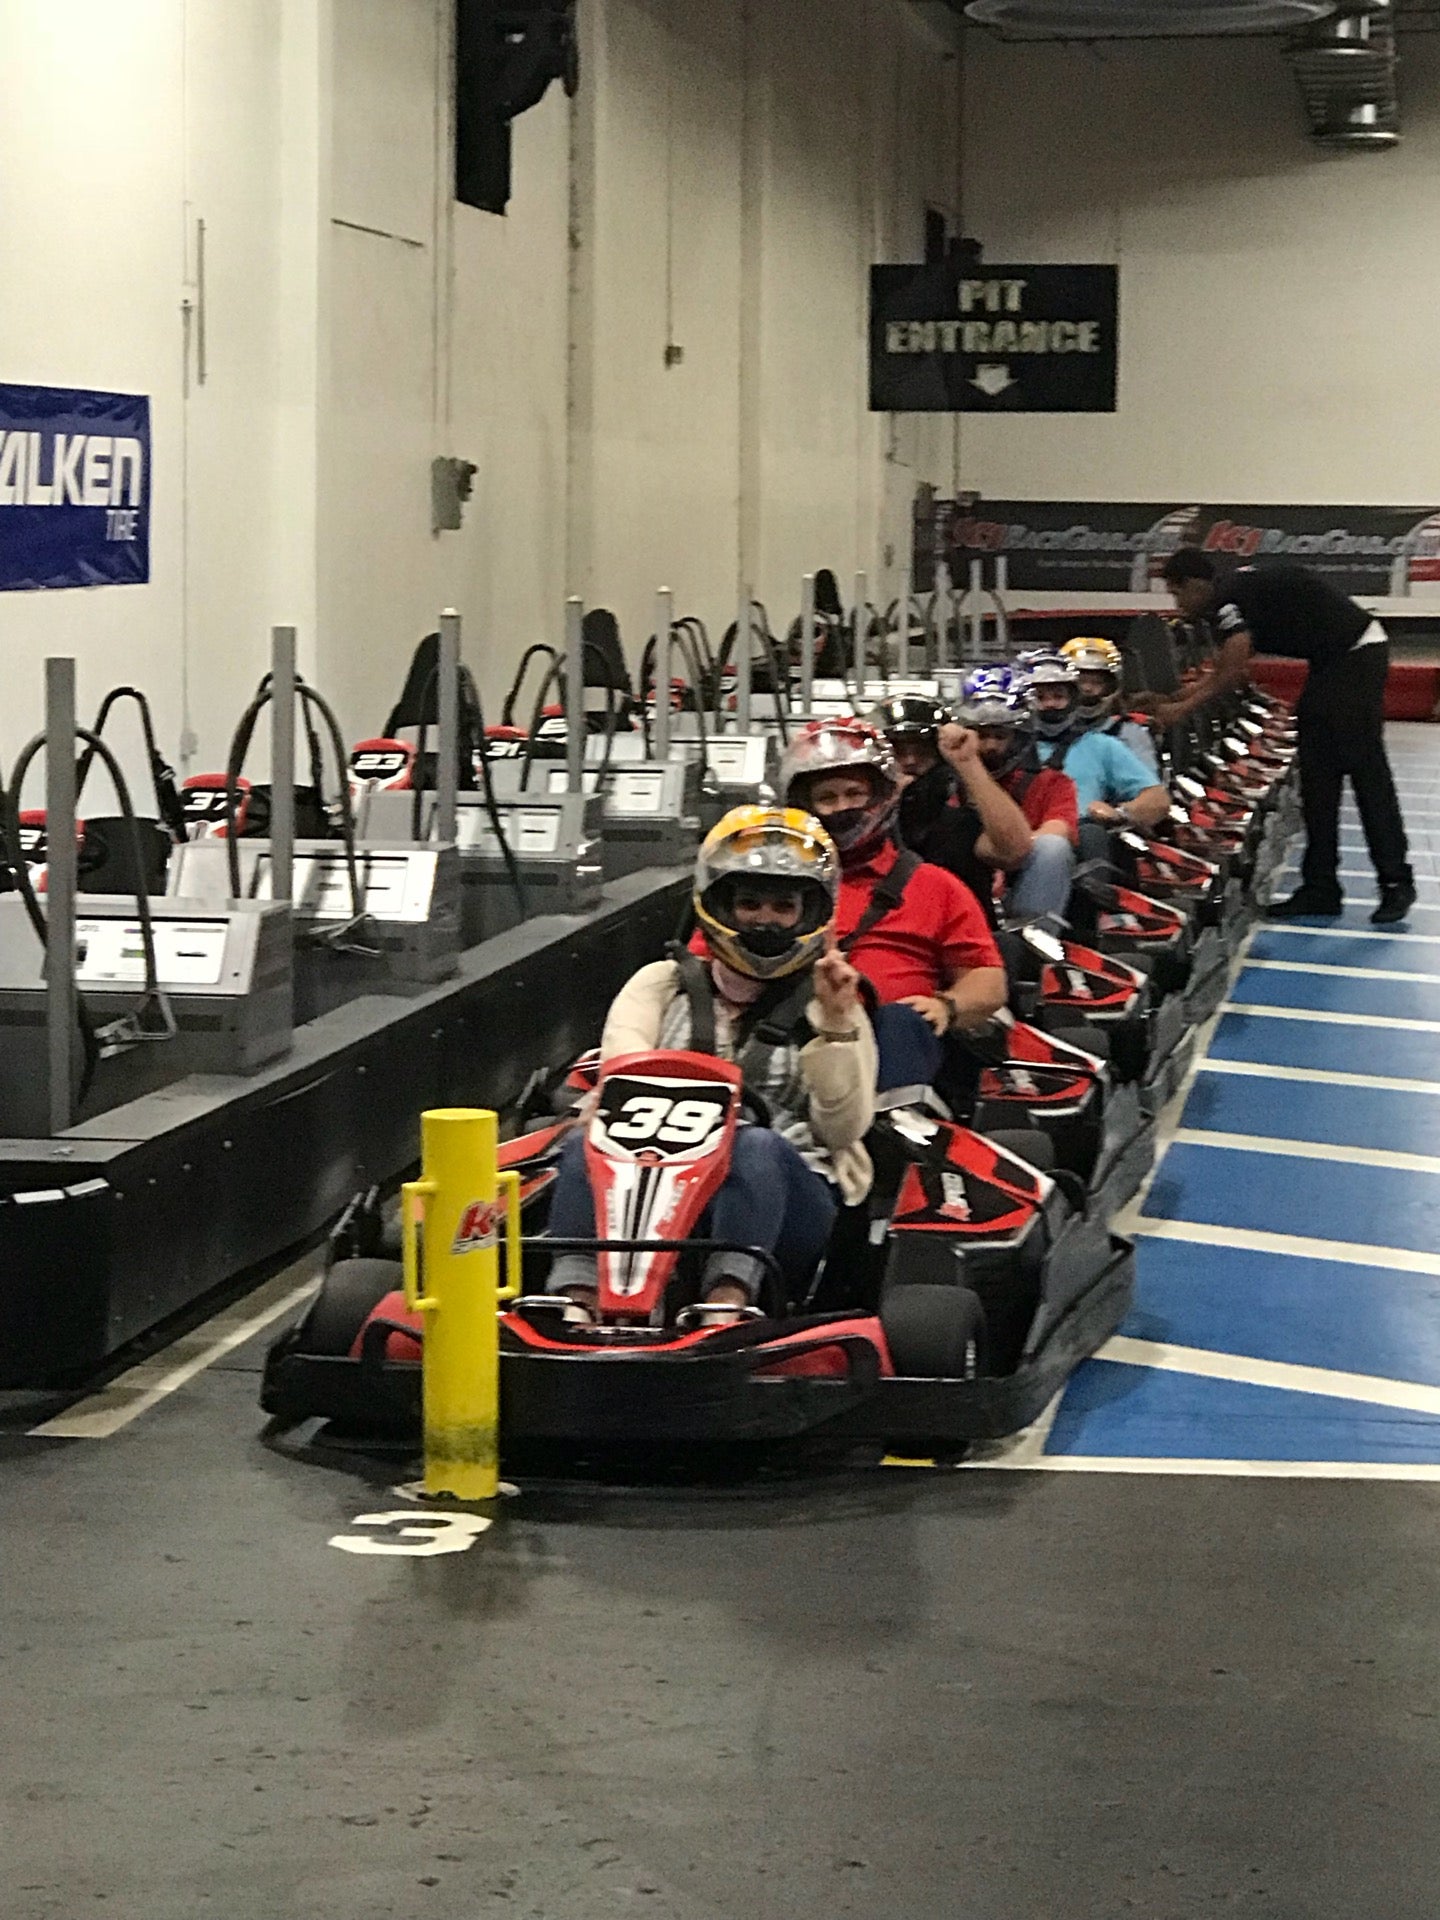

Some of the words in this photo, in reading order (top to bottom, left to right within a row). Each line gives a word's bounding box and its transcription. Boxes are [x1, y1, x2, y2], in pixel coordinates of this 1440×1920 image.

[957, 279, 1028, 312] PIT
[885, 320, 1101, 354] ENTRANCE
[0, 430, 141, 506] ALKEN
[354, 752, 404, 770] 23
[184, 791, 230, 811] 37
[607, 1096, 722, 1144] 39
[327, 1510, 493, 1556] 3
